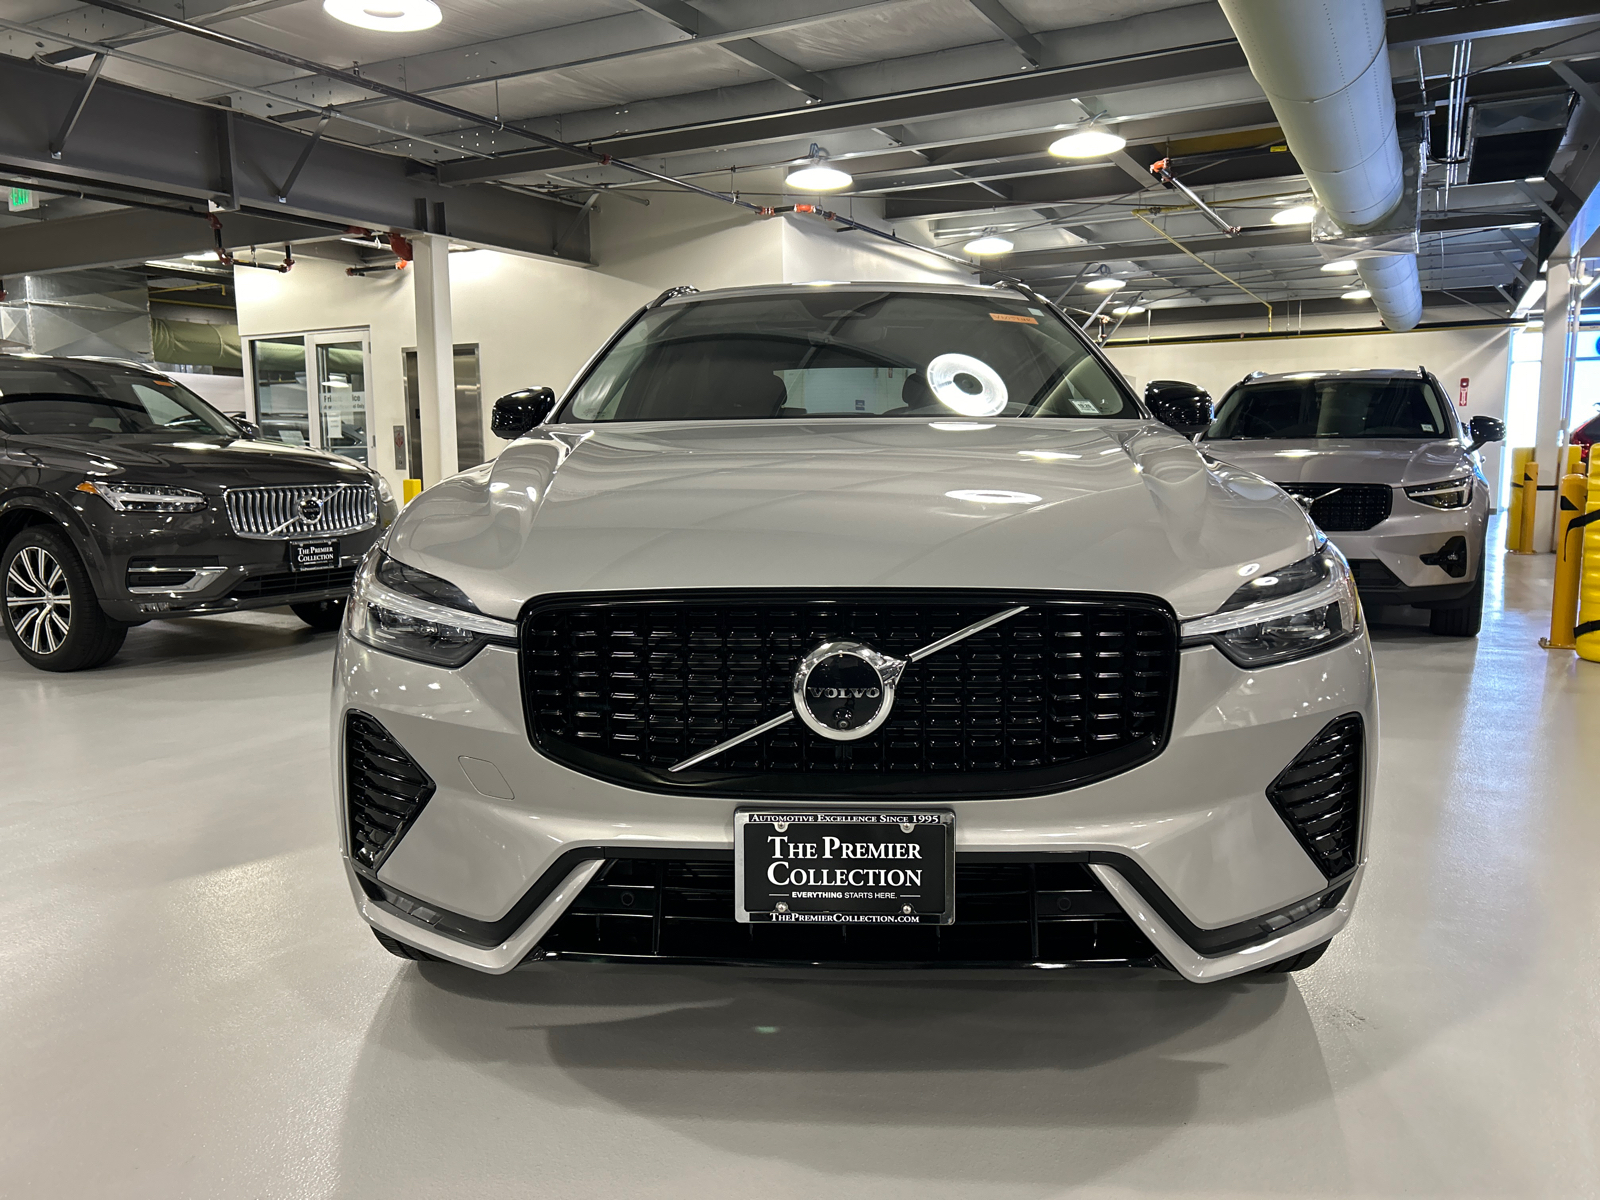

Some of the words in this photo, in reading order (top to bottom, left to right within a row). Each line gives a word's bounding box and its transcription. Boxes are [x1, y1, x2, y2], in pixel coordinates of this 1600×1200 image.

[297, 554, 334, 562] COLLECTION
[807, 687, 880, 698] VOLVO
[912, 815, 939, 824] 1995
[767, 835, 818, 859] THE
[821, 836, 923, 860] PREMIER
[766, 861, 923, 887] COLLECTION
[791, 891, 843, 899] EVERYTHING
[874, 892, 898, 900] HERE.
